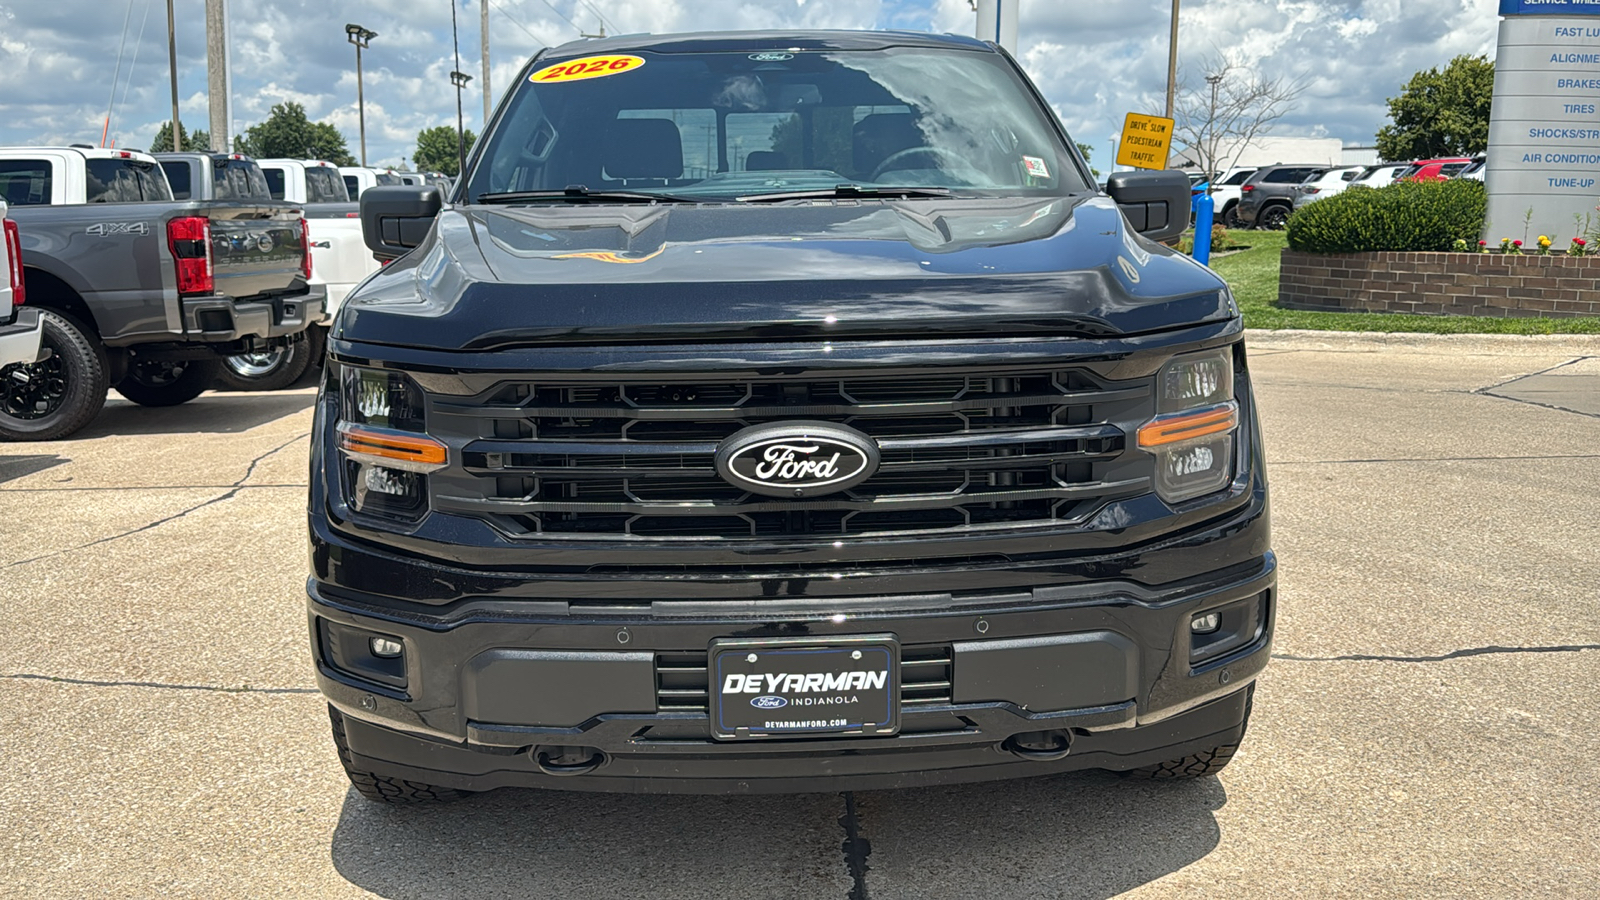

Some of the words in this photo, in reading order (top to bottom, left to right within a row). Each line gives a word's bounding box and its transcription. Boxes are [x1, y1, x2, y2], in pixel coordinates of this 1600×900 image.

[1555, 27, 1583, 37] FAST
[1550, 53, 1600, 63] ALIGNME
[540, 58, 633, 81] 2026
[1557, 78, 1600, 89] BRAKES
[1563, 104, 1595, 114] TIRES
[1130, 120, 1148, 131] DRIVE
[1150, 123, 1166, 133] SLOW
[1126, 135, 1163, 148] PEDESTRIAN
[1130, 150, 1155, 162] TRAFFIC
[1522, 153, 1542, 163] AIR
[1547, 178, 1595, 188] TUNE-UP
[755, 445, 841, 480] Ford
[722, 670, 888, 694] DEYARMAN
[791, 695, 859, 706] INDIANOLA
[765, 719, 847, 729] DEYARMANFORD.COM
